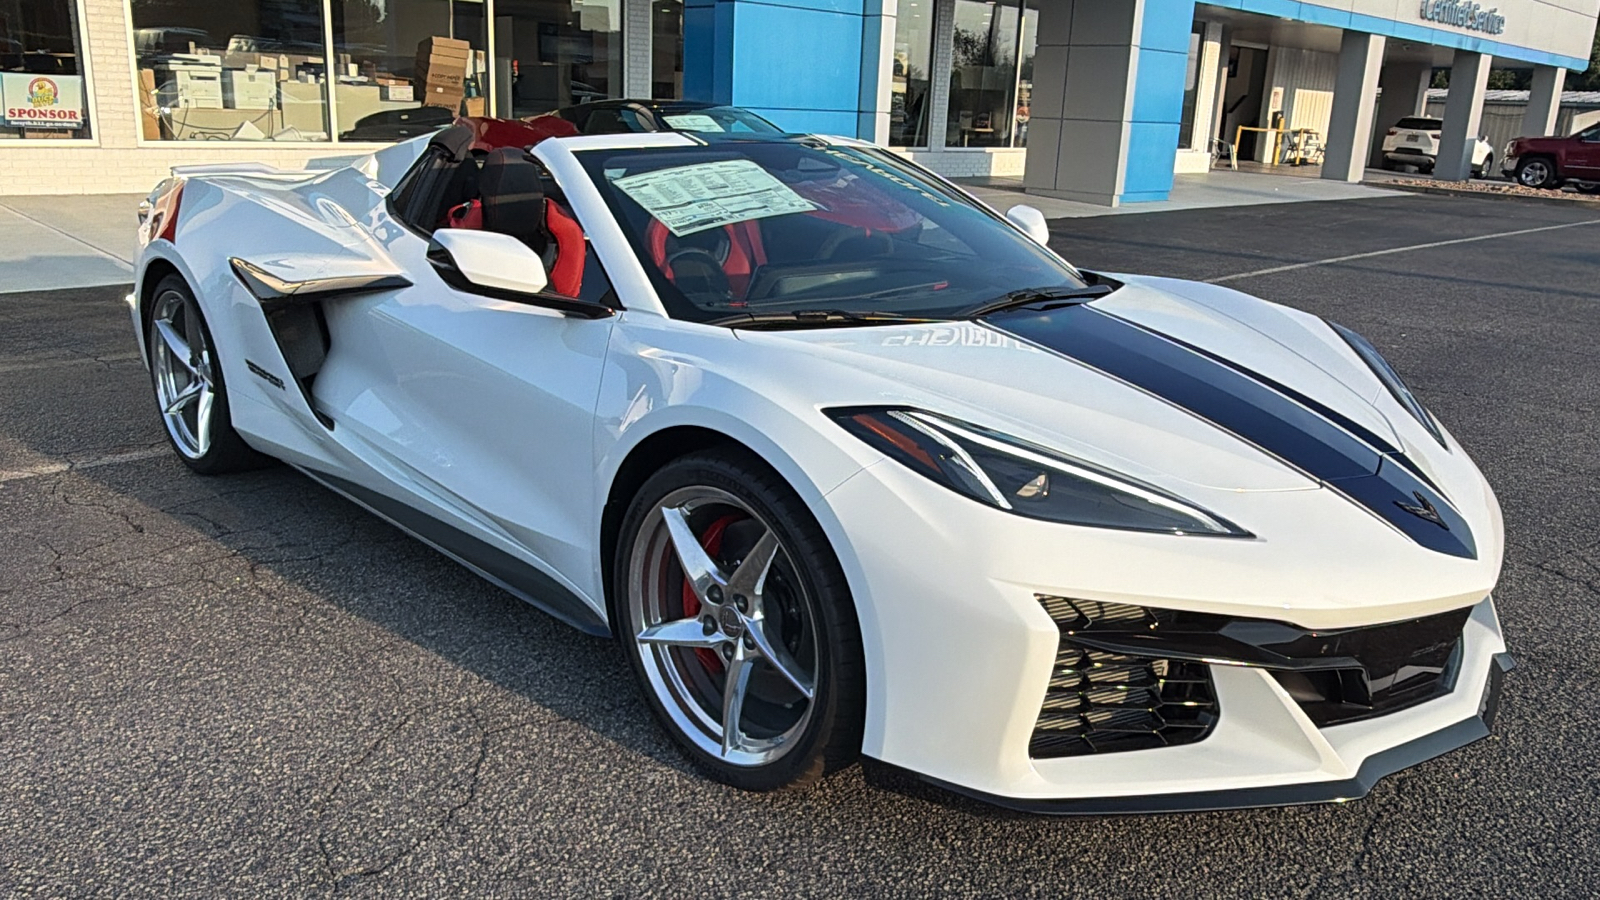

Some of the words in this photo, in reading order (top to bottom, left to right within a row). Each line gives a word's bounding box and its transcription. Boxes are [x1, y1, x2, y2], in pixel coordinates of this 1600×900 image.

[1420, 0, 1472, 27] Certified
[1472, 3, 1505, 35] Service
[8, 108, 79, 120] SPONSOR
